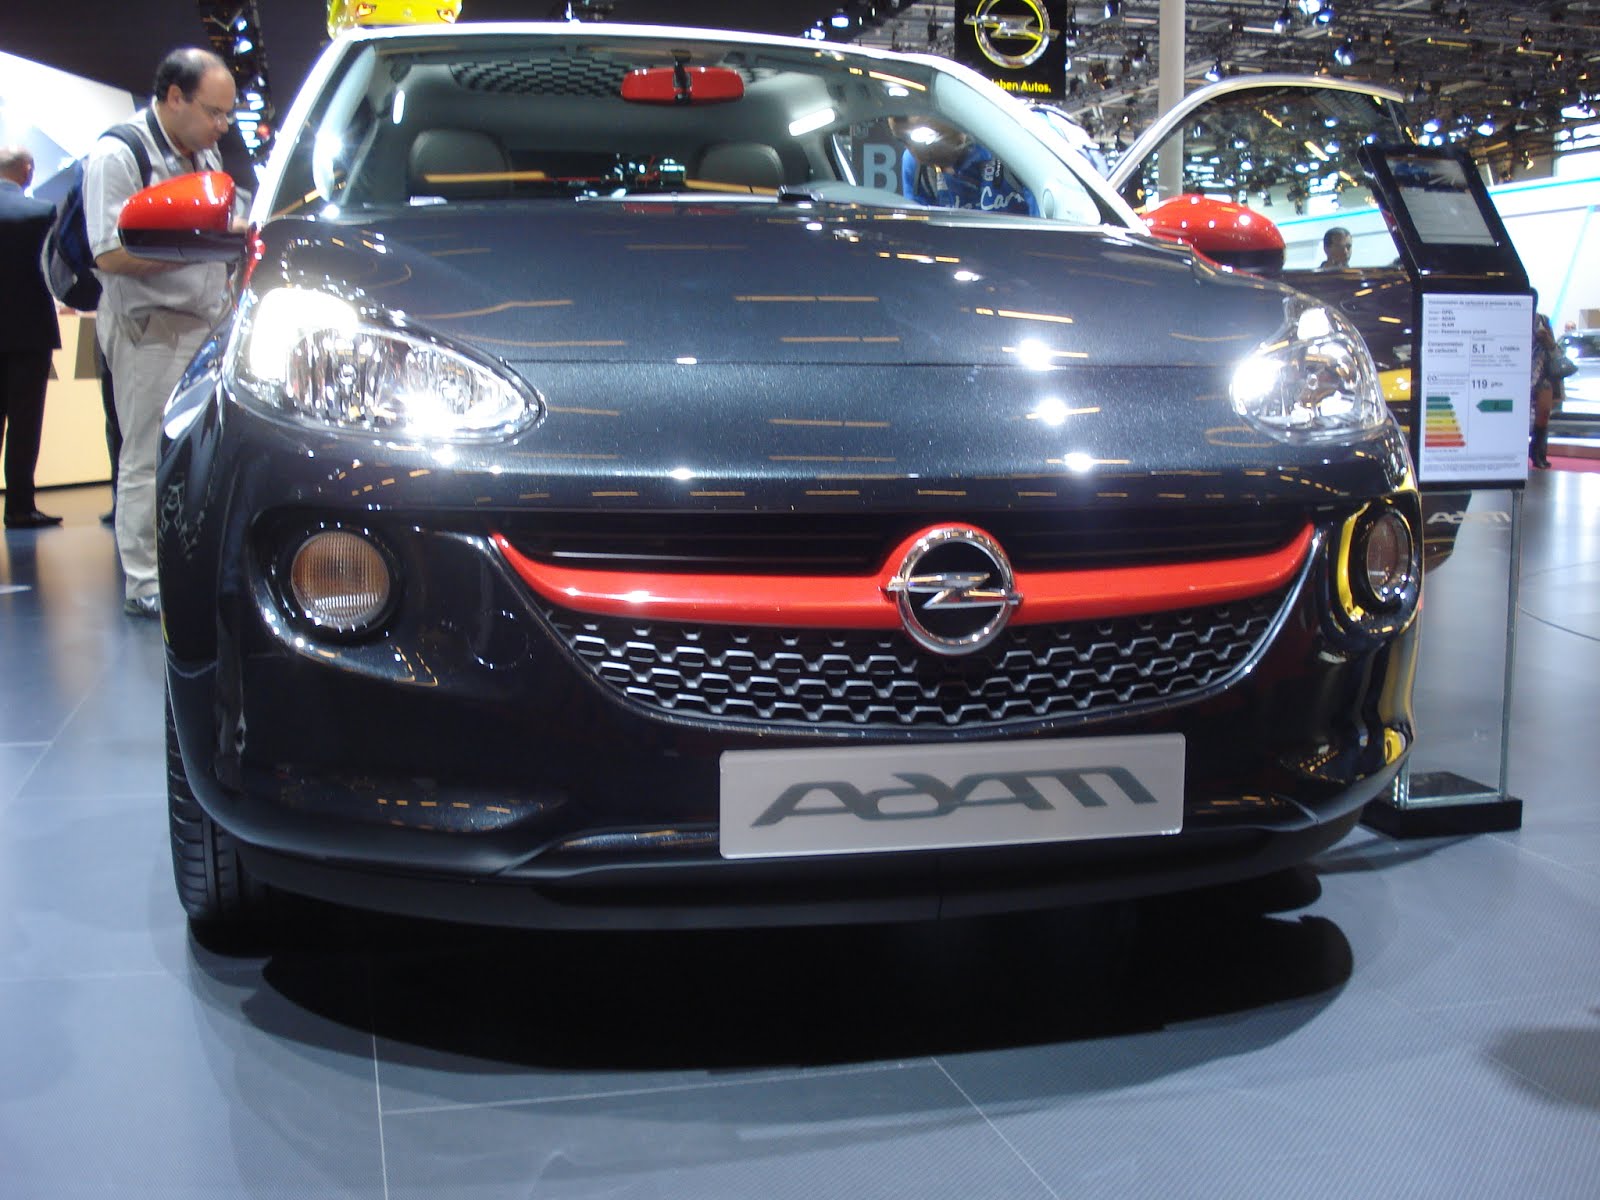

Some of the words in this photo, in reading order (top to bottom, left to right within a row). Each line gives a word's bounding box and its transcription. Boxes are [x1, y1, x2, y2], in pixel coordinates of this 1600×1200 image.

[1021, 81, 1052, 93] Autos.
[863, 144, 898, 192] B
[1471, 343, 1487, 354] 5.1
[1471, 379, 1488, 389] 119
